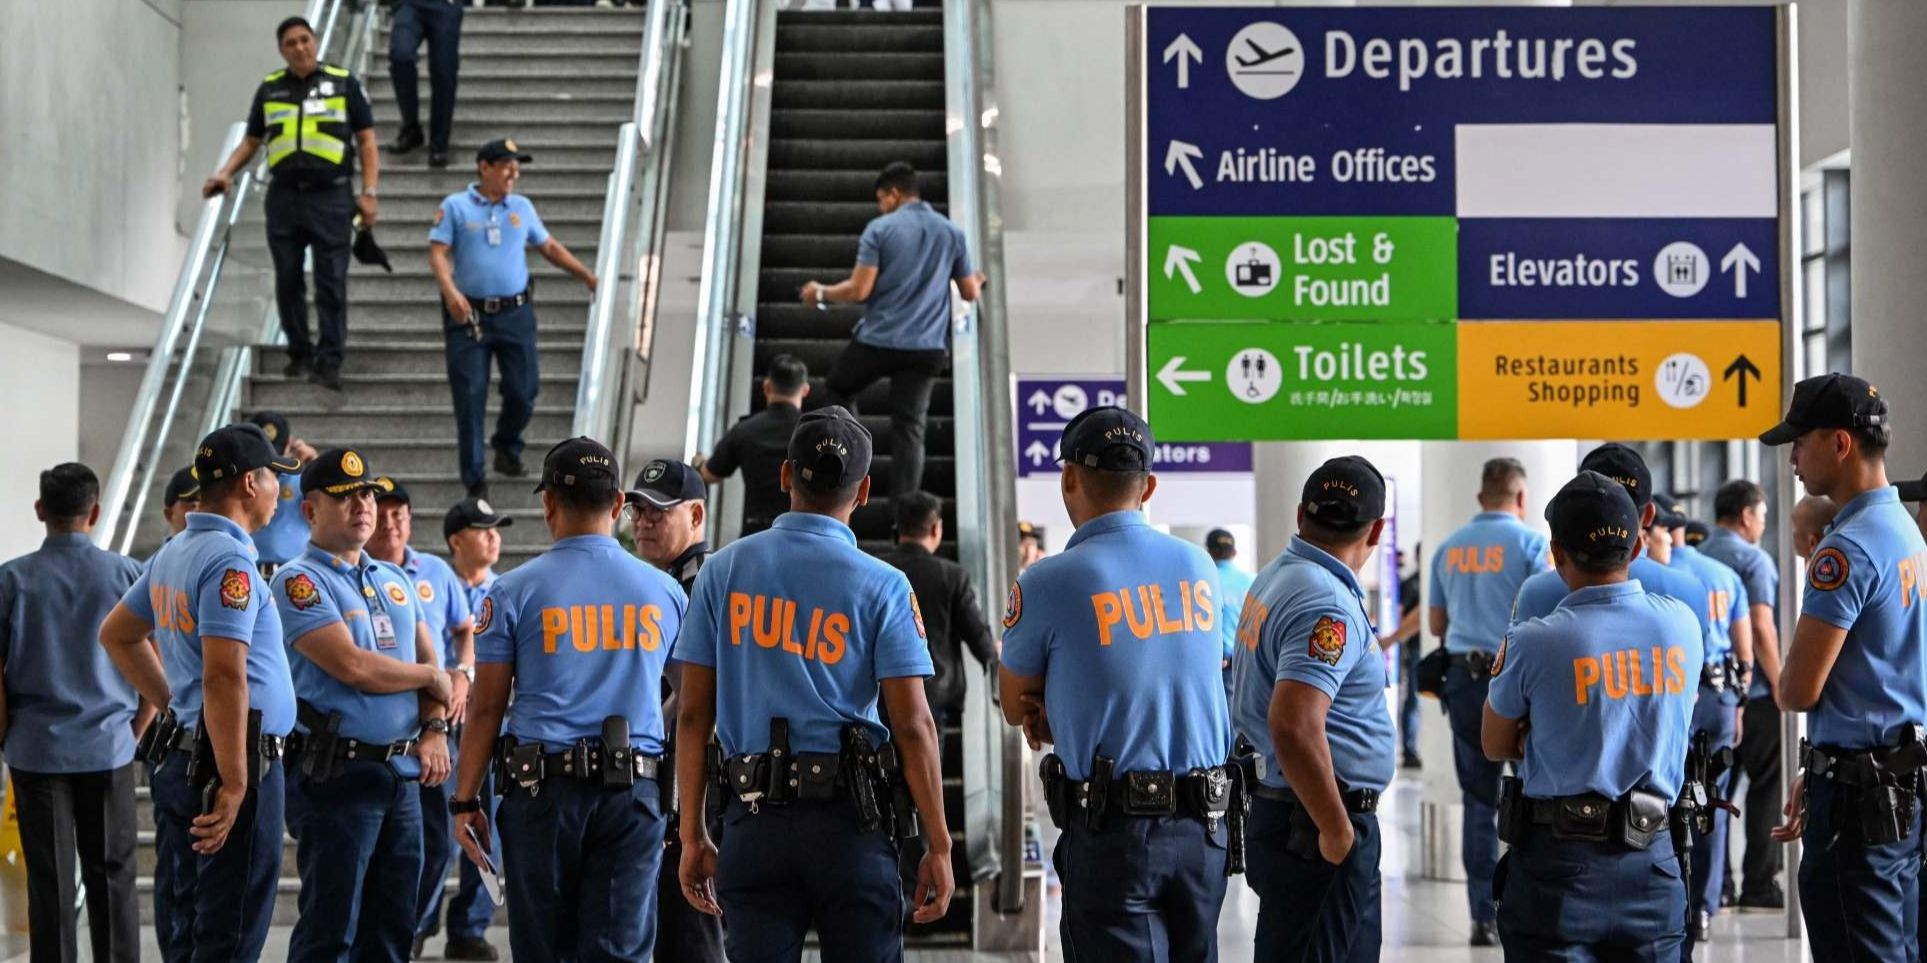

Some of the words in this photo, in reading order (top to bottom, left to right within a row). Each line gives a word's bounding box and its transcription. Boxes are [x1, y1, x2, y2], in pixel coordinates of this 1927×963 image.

[1325, 30, 1638, 91] Departures
[1216, 147, 1316, 182] Airline
[1331, 147, 1436, 182] Offices
[1293, 232, 1357, 265] Lost
[1372, 232, 1395, 264] &
[1490, 252, 1639, 286] Elevators
[1294, 272, 1390, 307] Found
[1293, 342, 1428, 381] Toilets
[1495, 355, 1638, 376] Restaurants
[1528, 381, 1639, 408] Shopping
[816, 437, 848, 456] PULIS
[1104, 426, 1144, 442] PULIS
[579, 455, 610, 467] PULIS
[1322, 480, 1359, 497] PULIS
[1589, 525, 1629, 542] PULIS
[1446, 545, 1504, 575] PULIS
[541, 603, 662, 655] PULIS
[729, 592, 850, 665] PULIS
[1091, 580, 1214, 646] PULIS
[1573, 646, 1686, 705] PULIS
